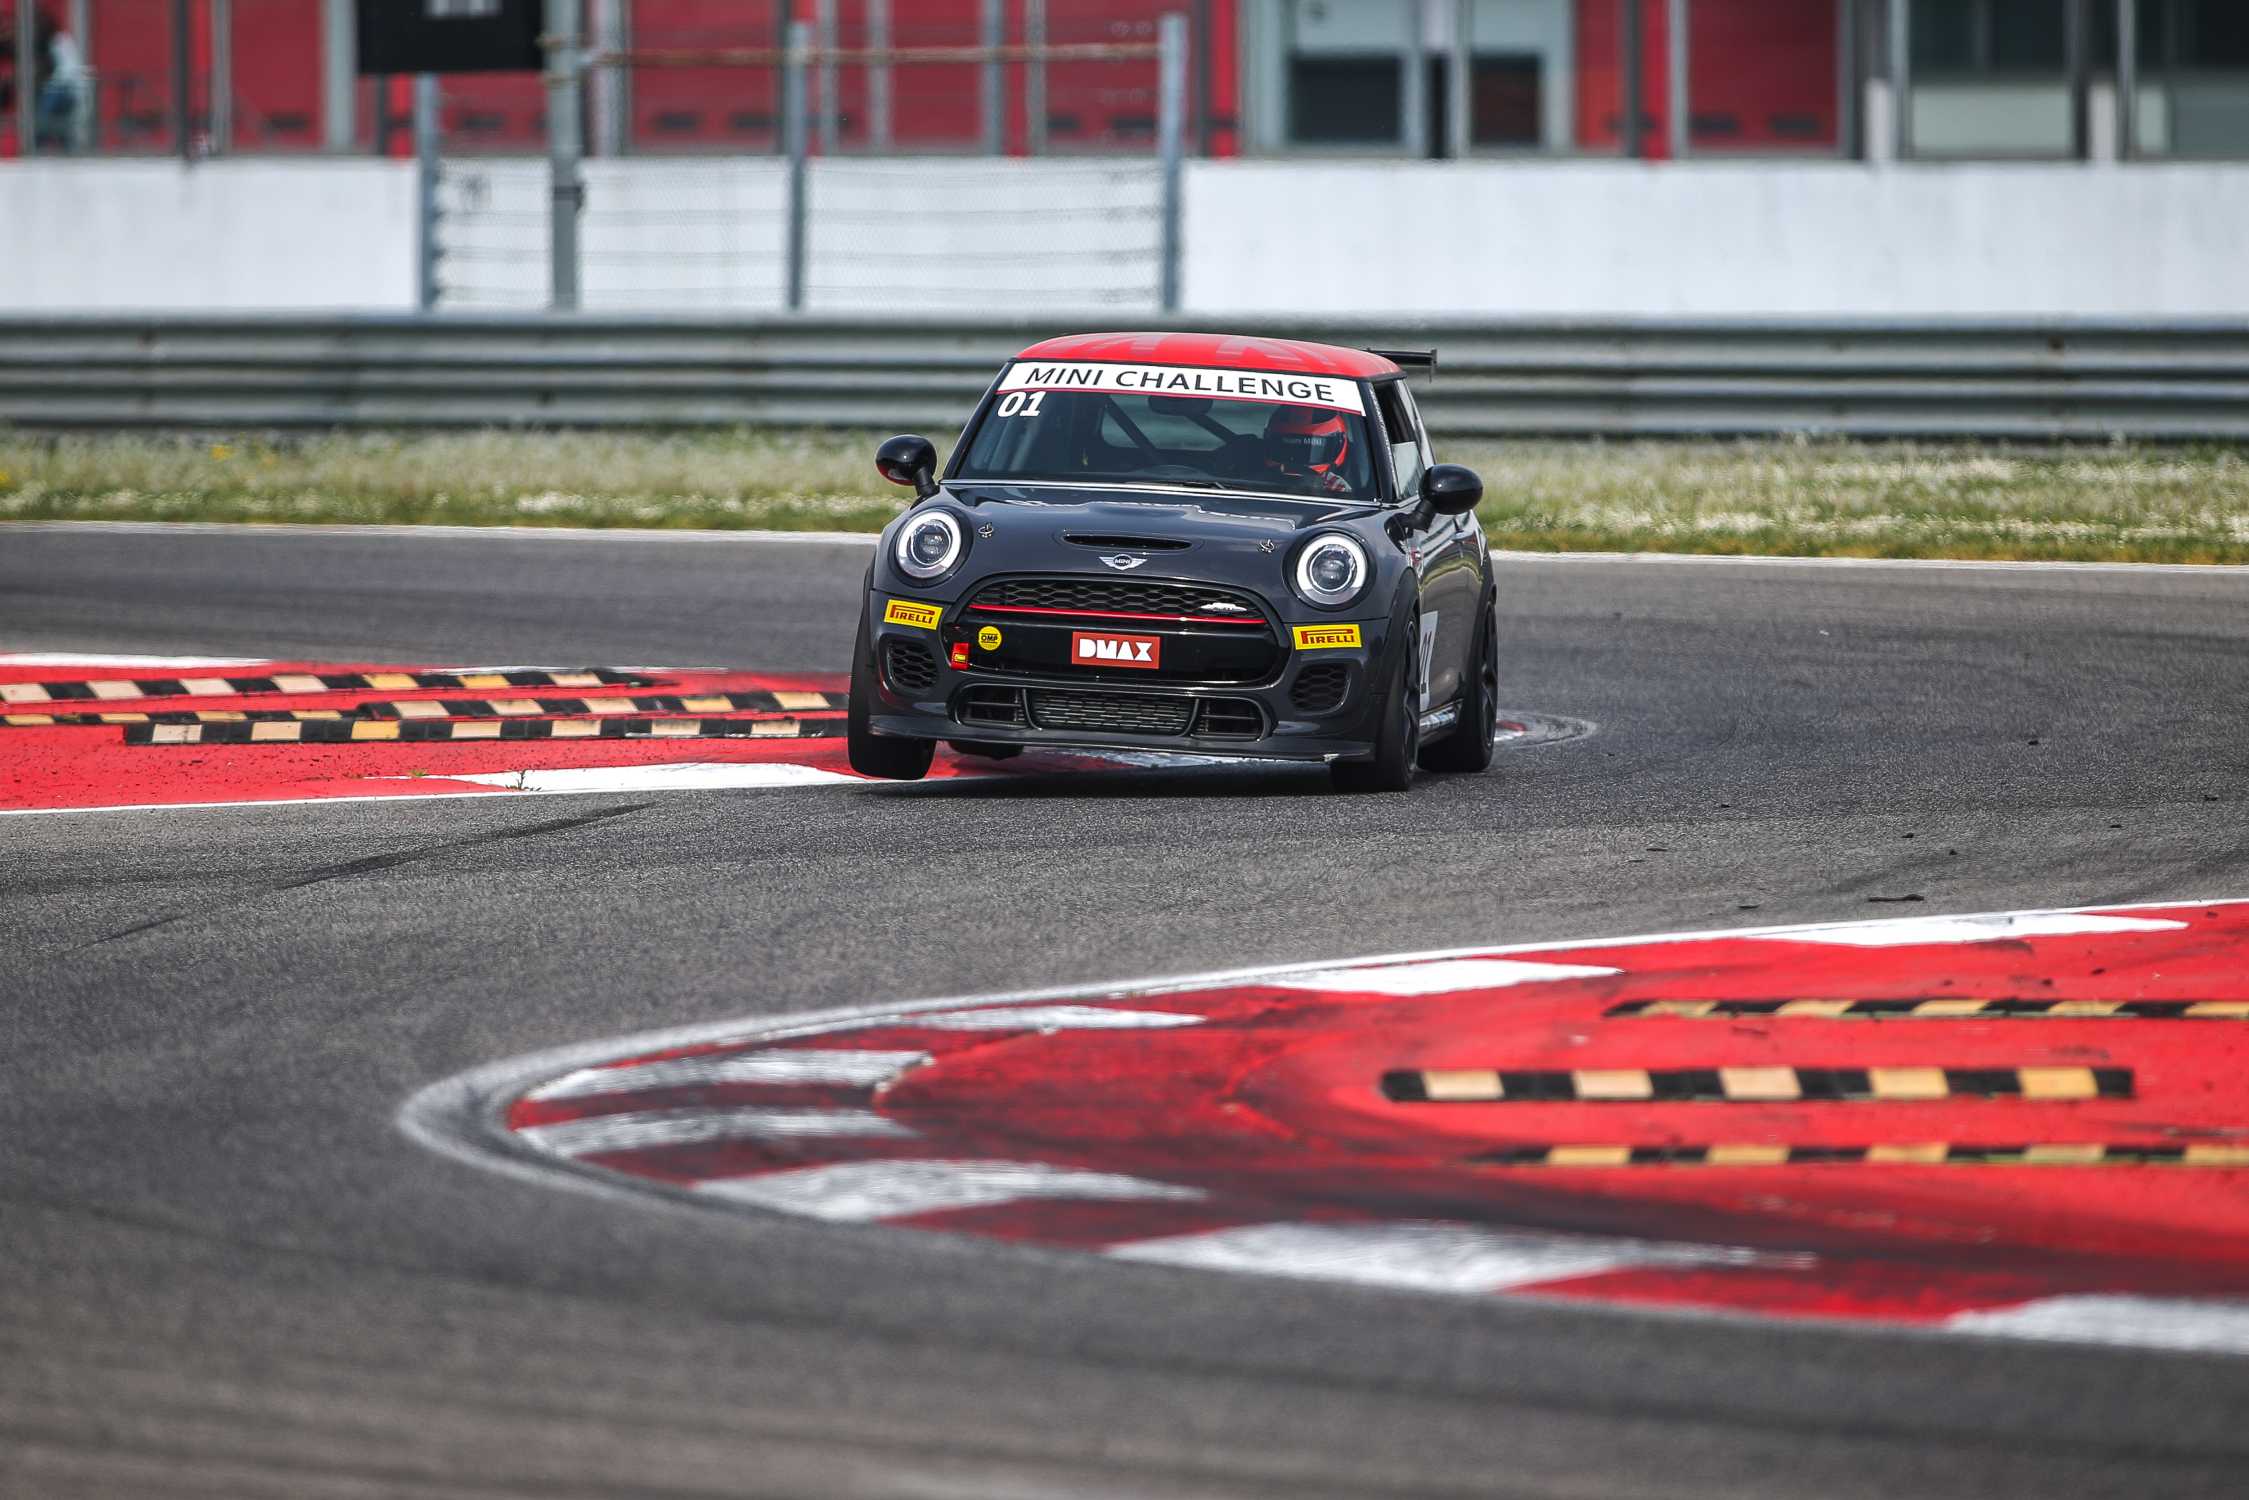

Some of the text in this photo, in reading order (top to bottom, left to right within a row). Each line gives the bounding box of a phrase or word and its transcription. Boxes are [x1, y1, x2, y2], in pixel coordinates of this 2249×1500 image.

[1024, 367, 1335, 402] MINI CHALLENGE
[997, 390, 1047, 418] 01
[889, 604, 936, 624] PIRELLI
[1300, 628, 1355, 645] PIRELLI
[1078, 638, 1153, 662] DMAX
